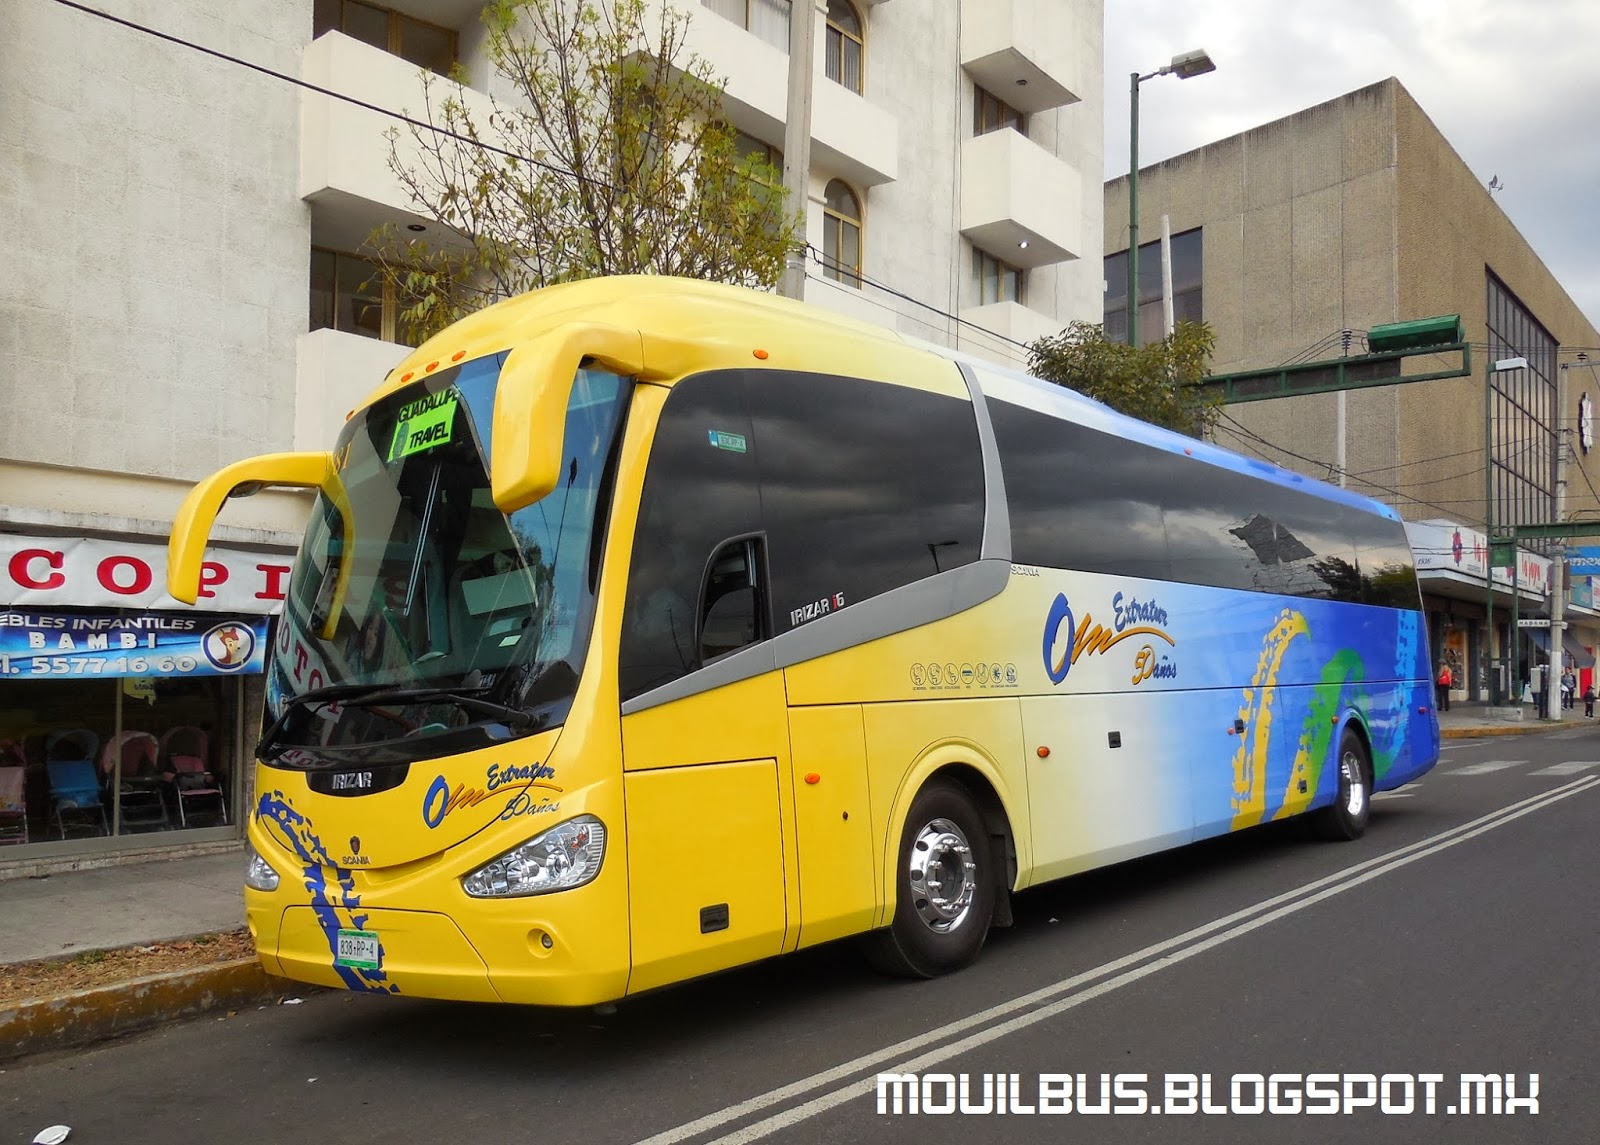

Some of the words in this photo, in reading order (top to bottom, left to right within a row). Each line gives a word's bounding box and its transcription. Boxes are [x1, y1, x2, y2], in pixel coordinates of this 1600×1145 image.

[409, 421, 448, 449] TRAVEL
[1011, 565, 1040, 577] SCANIA
[790, 598, 830, 626] IRIZAR
[832, 591, 845, 610] i6
[1113, 591, 1168, 632] Extratur
[72, 618, 196, 631] INFANTILES
[29, 631, 156, 650] BAMBI
[0, 654, 20, 674] l.
[31, 656, 107, 674] 5577
[118, 656, 149, 673] 16
[157, 656, 197, 673] 60
[332, 772, 372, 790] IRIZAR
[487, 762, 556, 791] Extratur
[342, 856, 371, 865] SCANIA
